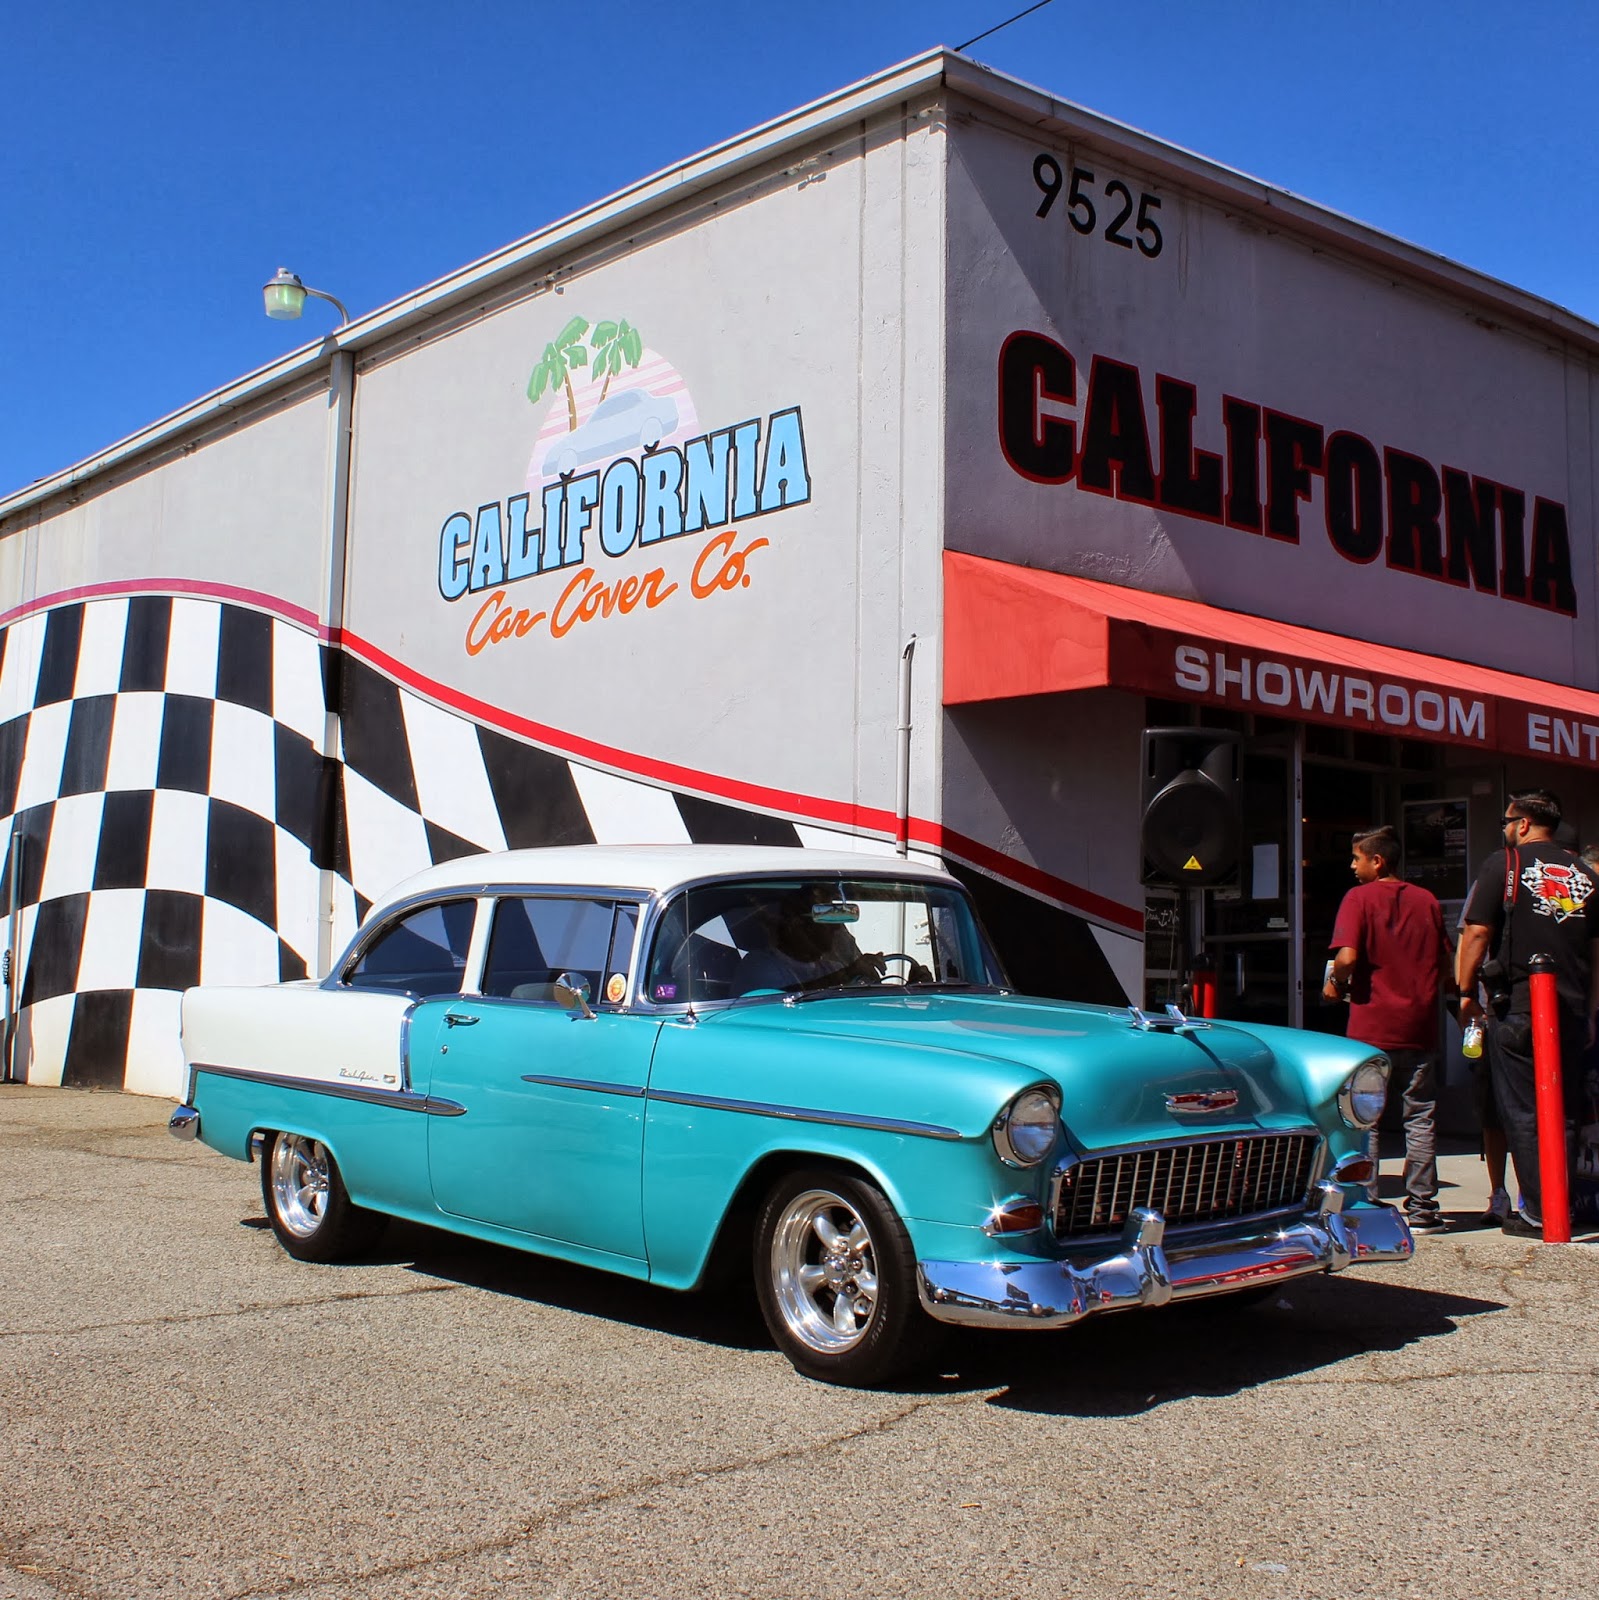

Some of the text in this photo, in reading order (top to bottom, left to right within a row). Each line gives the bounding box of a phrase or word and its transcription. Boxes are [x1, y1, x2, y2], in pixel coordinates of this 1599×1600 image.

[1032, 153, 1163, 258] 9525
[438, 405, 811, 602] CALIFORNIA
[999, 330, 1577, 617] CALIFORNIA
[465, 530, 769, 657] Car Cover Co.
[1174, 645, 1599, 761] SHOWROOM ENT
